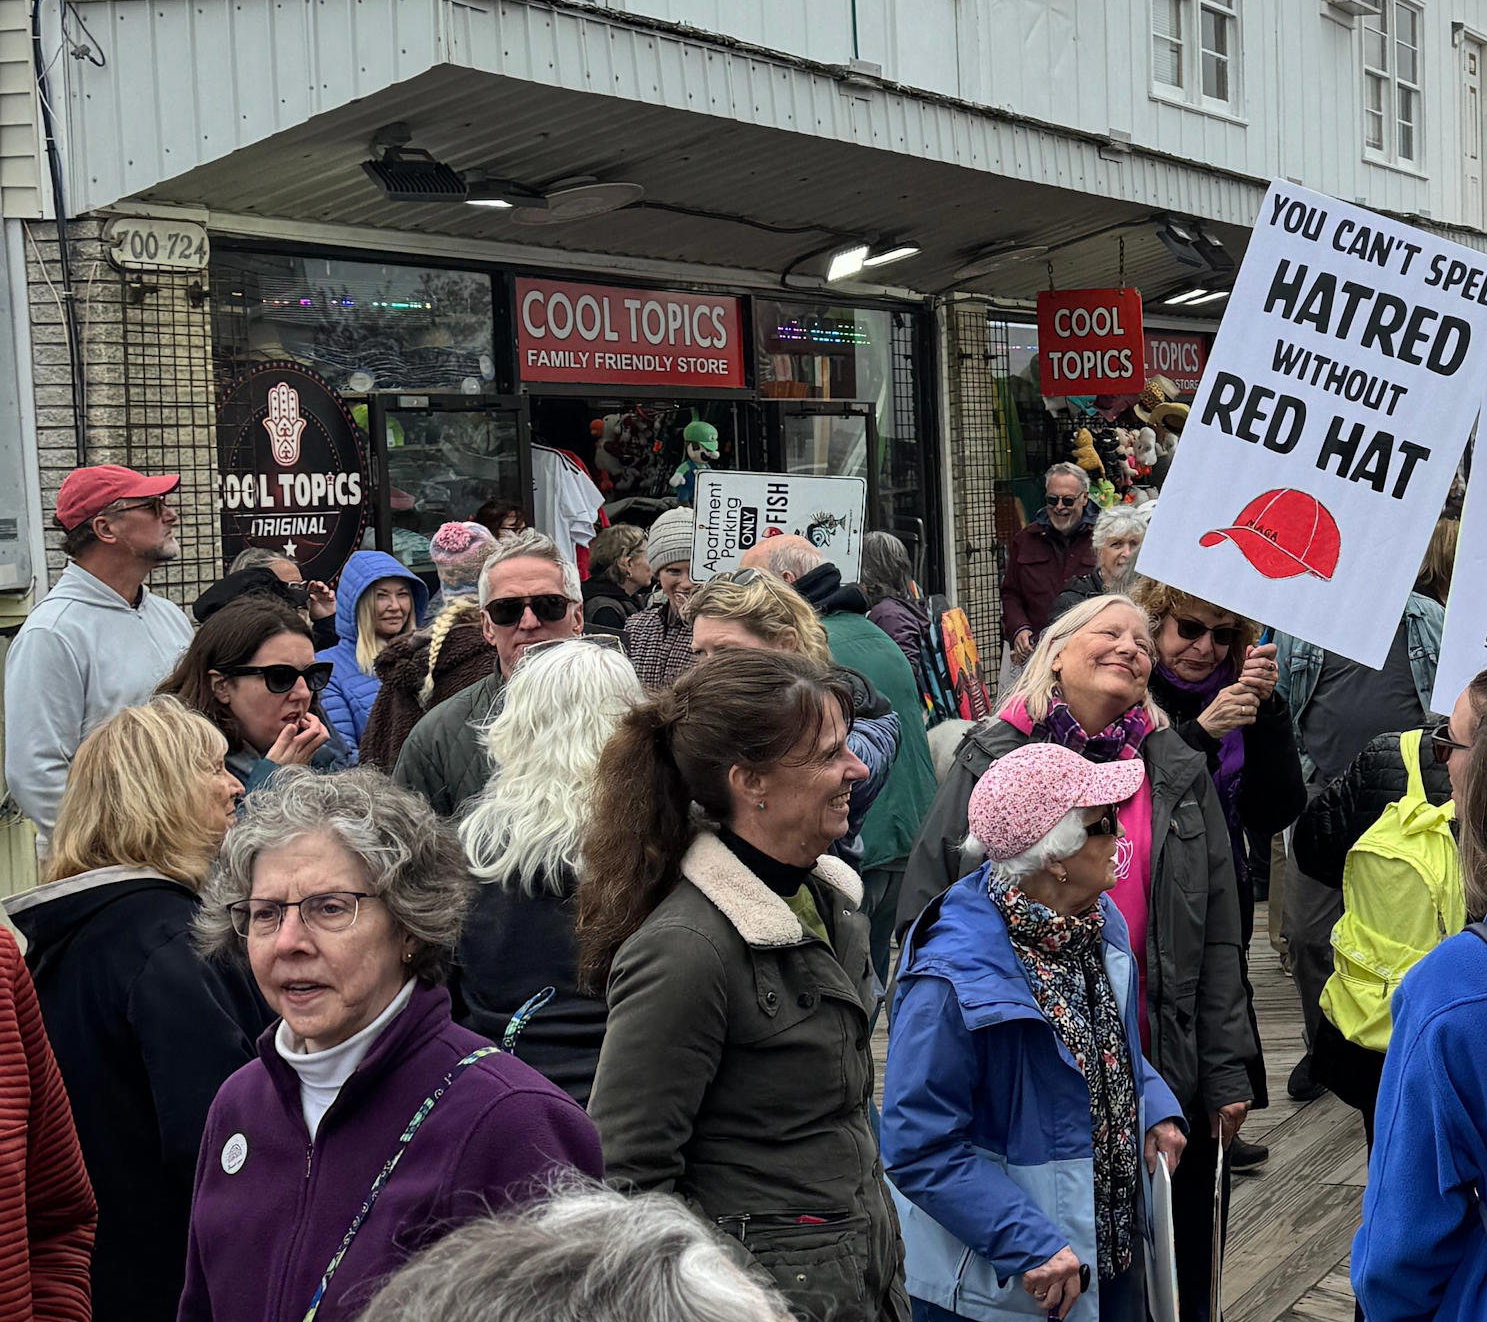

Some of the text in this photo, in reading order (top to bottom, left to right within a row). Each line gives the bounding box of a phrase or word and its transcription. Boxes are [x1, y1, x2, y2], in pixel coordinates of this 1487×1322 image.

[1270, 193, 1328, 241] YOU
[1333, 219, 1422, 275] CAN'T
[522, 290, 727, 349] COOL TOPICS
[1054, 307, 1124, 338] COOL
[1263, 258, 1471, 376] HATRED
[527, 349, 728, 375] FAMILY FRIENDLY STORE
[1049, 349, 1133, 379] TOPICS
[1151, 341, 1198, 372] TOPICS
[1271, 338, 1408, 416] WITHOUT
[1175, 379, 1199, 390] STORE
[1200, 370, 1431, 500] RED HAT
[766, 483, 789, 524] FISH
[703, 482, 722, 572] Apartment
[721, 497, 742, 558] Parking
[741, 510, 756, 546] ONLY
[1246, 519, 1278, 542] MAGA
